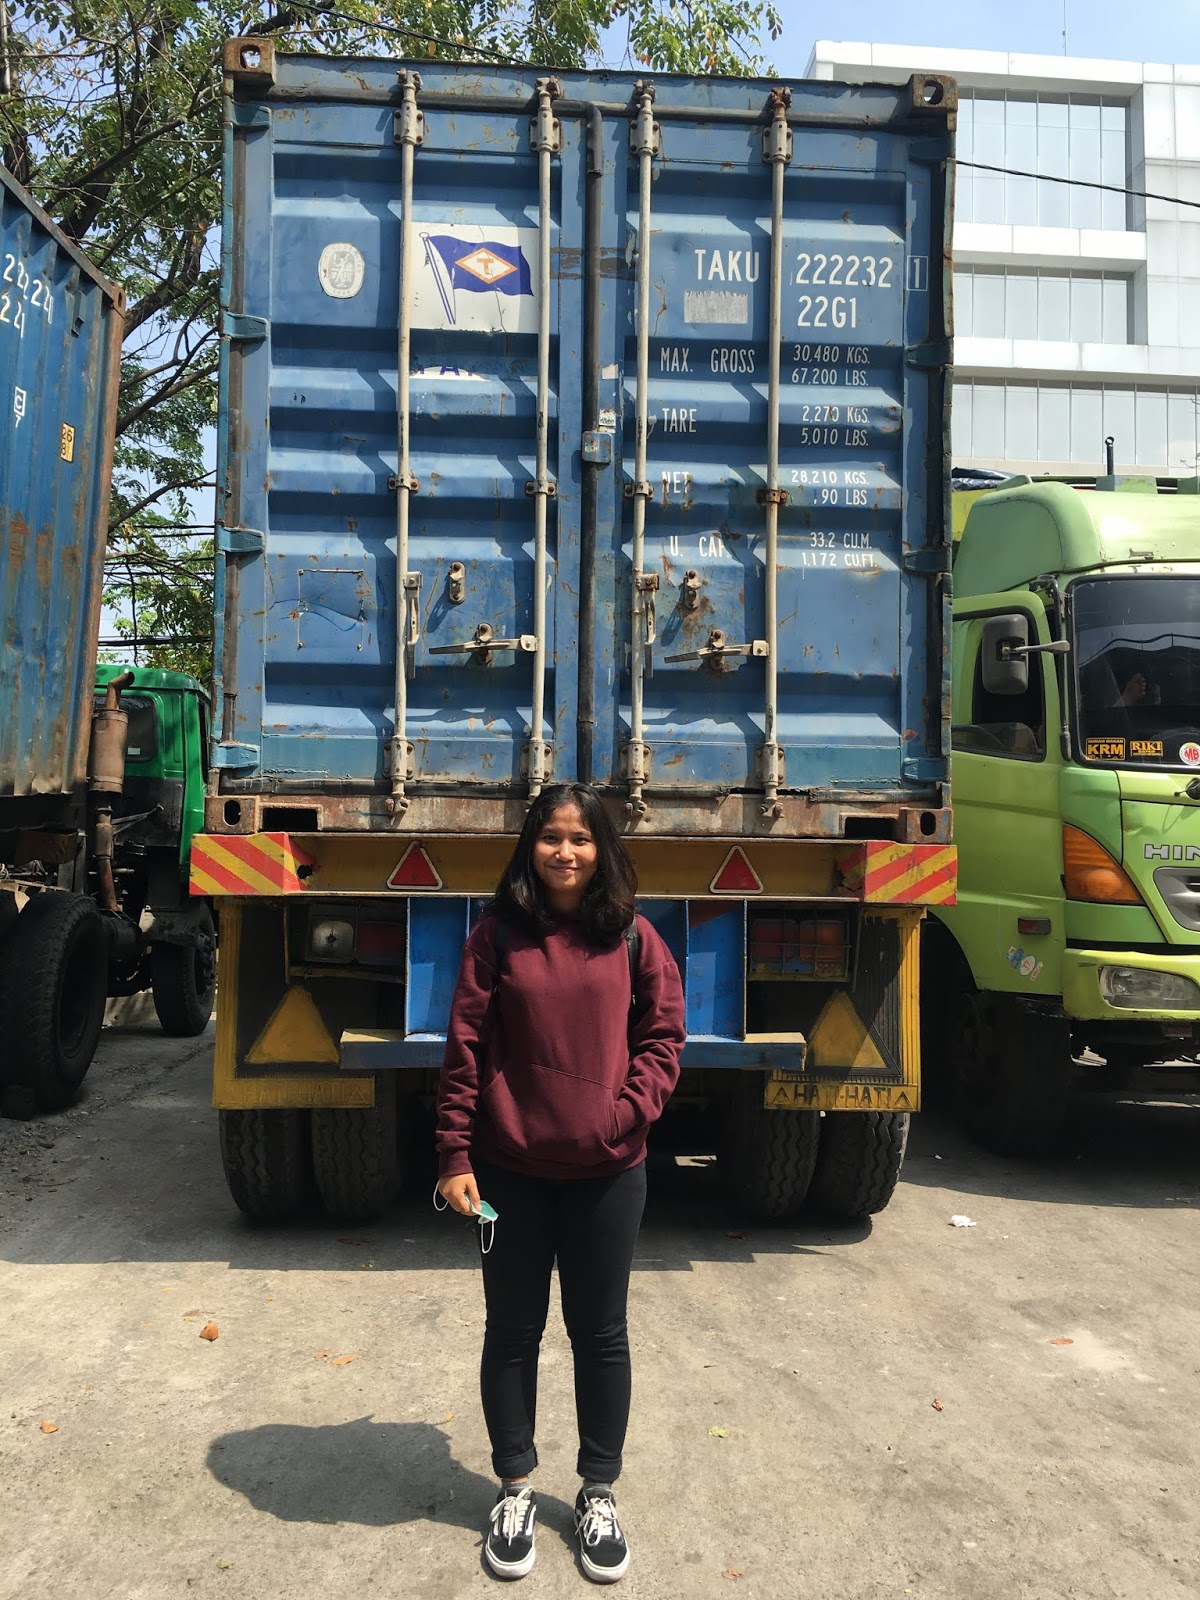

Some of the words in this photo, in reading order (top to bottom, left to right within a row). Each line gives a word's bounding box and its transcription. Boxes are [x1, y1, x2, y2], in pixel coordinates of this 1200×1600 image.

[695, 249, 760, 283] TAKU
[796, 253, 893, 288] 222232
[797, 295, 857, 329] 22G1
[660, 347, 693, 373] MAX.
[711, 348, 756, 374] GROSS
[793, 344, 840, 363] 30,480
[846, 346, 870, 364] KGS.
[791, 367, 837, 385] 67,200
[845, 369, 869, 386] LBS.
[663, 408, 697, 433] TARE
[802, 405, 839, 423] 2,270
[847, 406, 870, 424] KGS.
[801, 427, 838, 445] 5,010
[845, 428, 869, 446] LBS.
[662, 471, 690, 493] NET
[791, 469, 838, 484] 28,210
[844, 471, 870, 485] KGS.
[845, 489, 867, 505] LBS
[810, 531, 835, 548] 33.2
[1088, 744, 1124, 755] KRM
[1132, 741, 1162, 751] RIKI
[1184, 747, 1200, 761] MB
